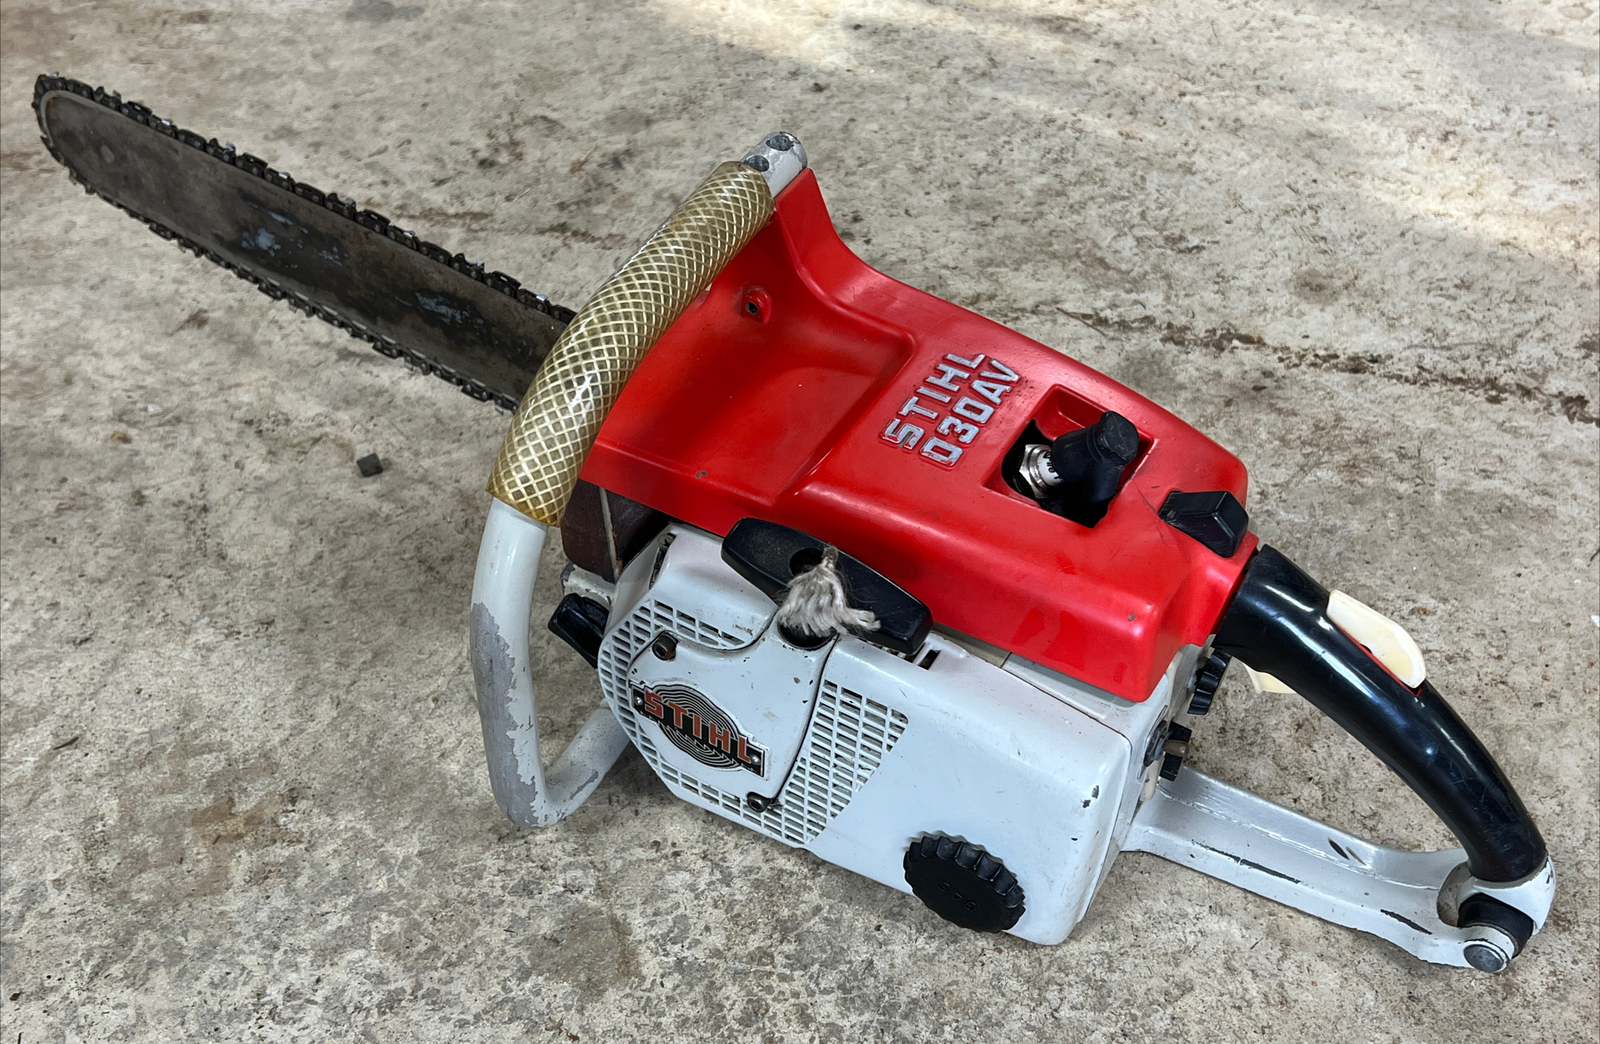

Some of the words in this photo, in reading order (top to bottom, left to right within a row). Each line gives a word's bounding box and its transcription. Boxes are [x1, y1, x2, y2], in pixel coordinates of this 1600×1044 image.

[881, 352, 986, 451] STIHL
[643, 688, 752, 763] STIHL
[937, 880, 978, 913] GAS
